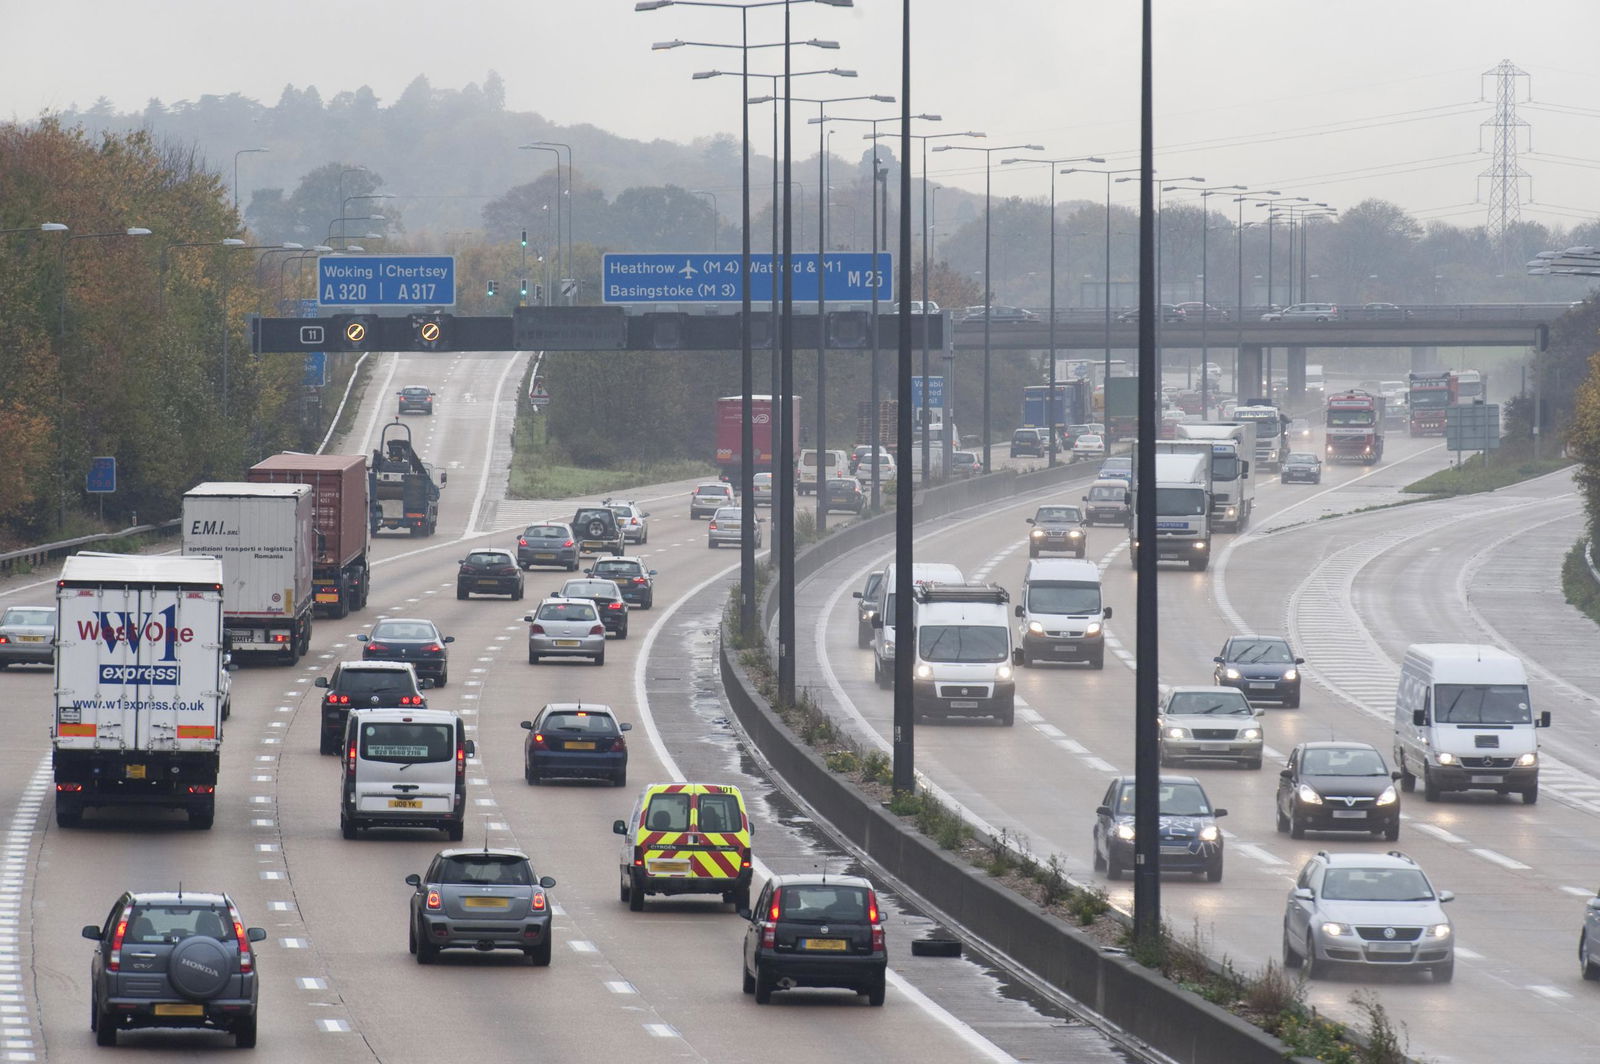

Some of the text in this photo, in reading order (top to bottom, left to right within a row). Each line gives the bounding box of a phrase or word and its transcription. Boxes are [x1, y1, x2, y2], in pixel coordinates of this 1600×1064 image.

[324, 265, 373, 280] Woking
[386, 264, 448, 280] Chertsey
[610, 261, 675, 274] Heathrow
[749, 260, 802, 273] Watd
[806, 261, 816, 273] &
[610, 285, 694, 298] Basingstoke
[308, 330, 316, 340] 11
[191, 520, 226, 535] E.M.I.
[145, 621, 194, 643] One
[102, 665, 176, 682] express
[73, 699, 205, 712] www.w1express.co.uk
[181, 958, 219, 978] HONDA
